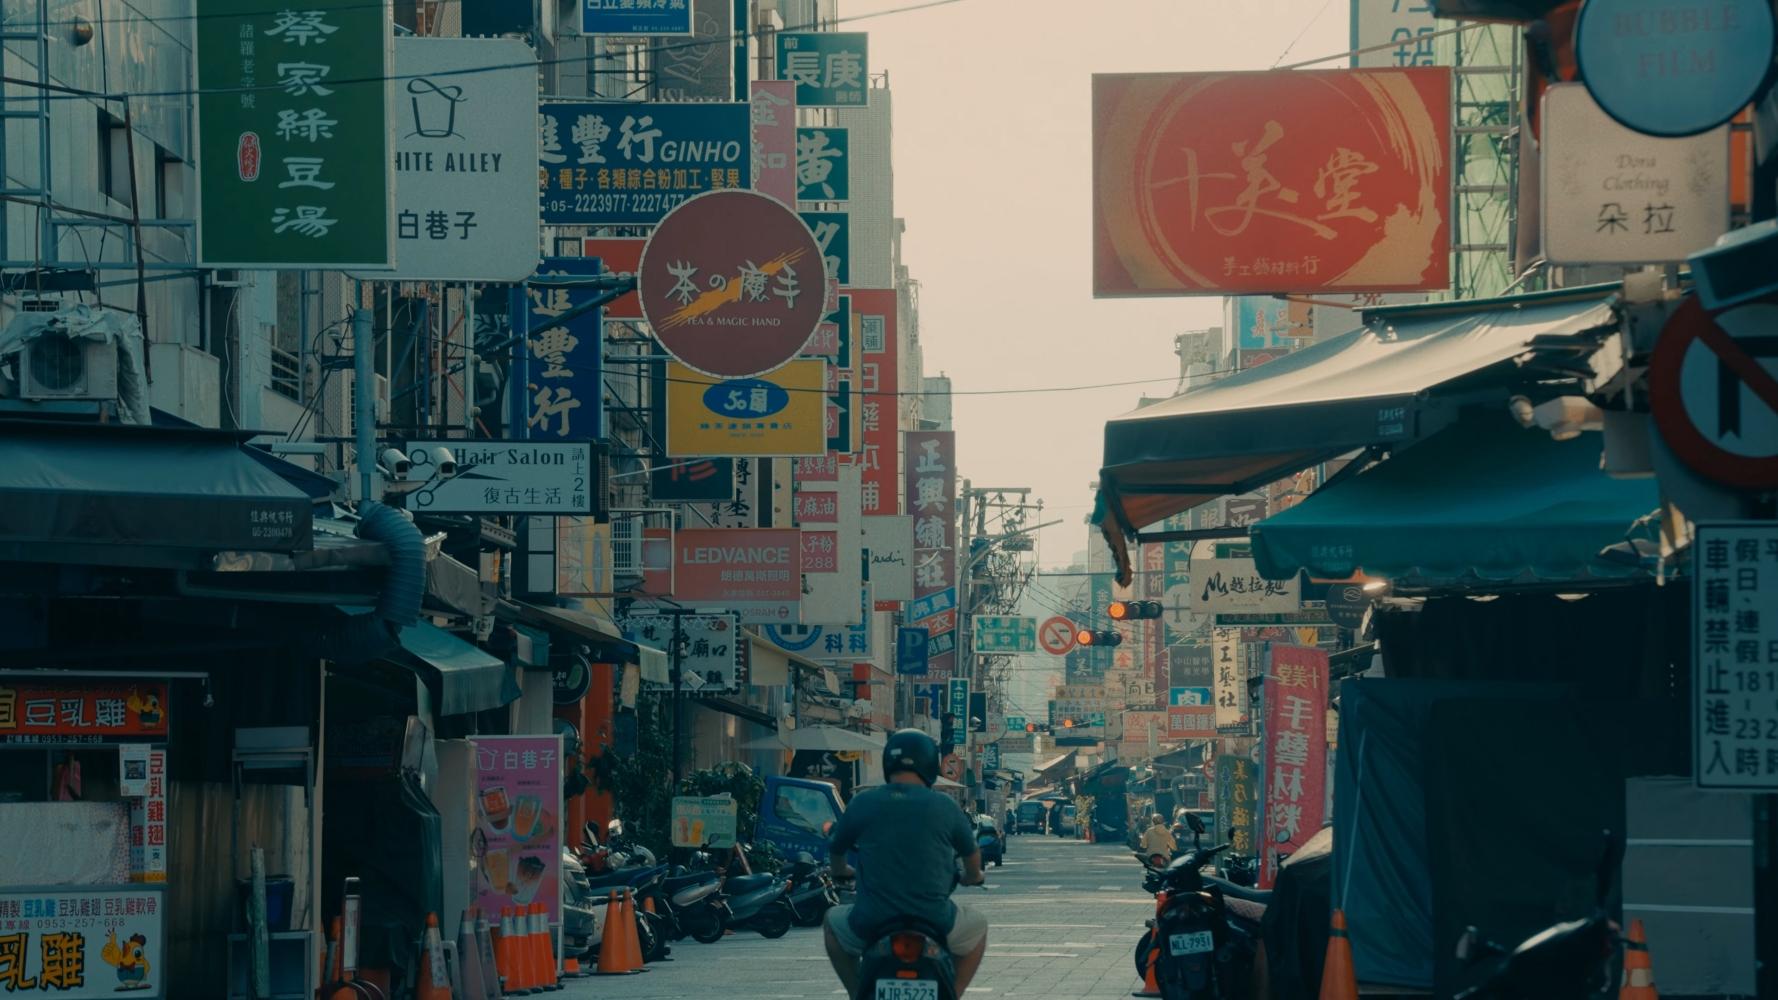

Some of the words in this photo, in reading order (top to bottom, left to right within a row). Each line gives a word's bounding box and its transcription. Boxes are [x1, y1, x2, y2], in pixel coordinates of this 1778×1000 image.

[783, 51, 862, 89] 長庚
[1639, 48, 1717, 80] FILM
[263, 10, 340, 238] 蔡家綠豆湯
[659, 141, 741, 163] GINHO
[395, 153, 432, 173] HITE
[446, 153, 503, 174] ALLEY
[398, 209, 478, 240] 白巷子
[1597, 202, 1676, 235] 朵拉
[664, 258, 803, 310] 茶の魔手
[716, 318, 749, 327] MAGIC
[752, 318, 781, 327] HAND
[455, 449, 497, 465] Hair
[508, 449, 564, 465] Salon
[484, 487, 560, 505] 復古生活
[683, 547, 790, 564] LEDVANCE
[904, 631, 924, 657] P
[24, 698, 126, 727] 豆乳雞
[504, 749, 556, 770] 白巷子
[24, 899, 55, 918] 豆乳雞
[37, 917, 125, 930] 0953-257-668
